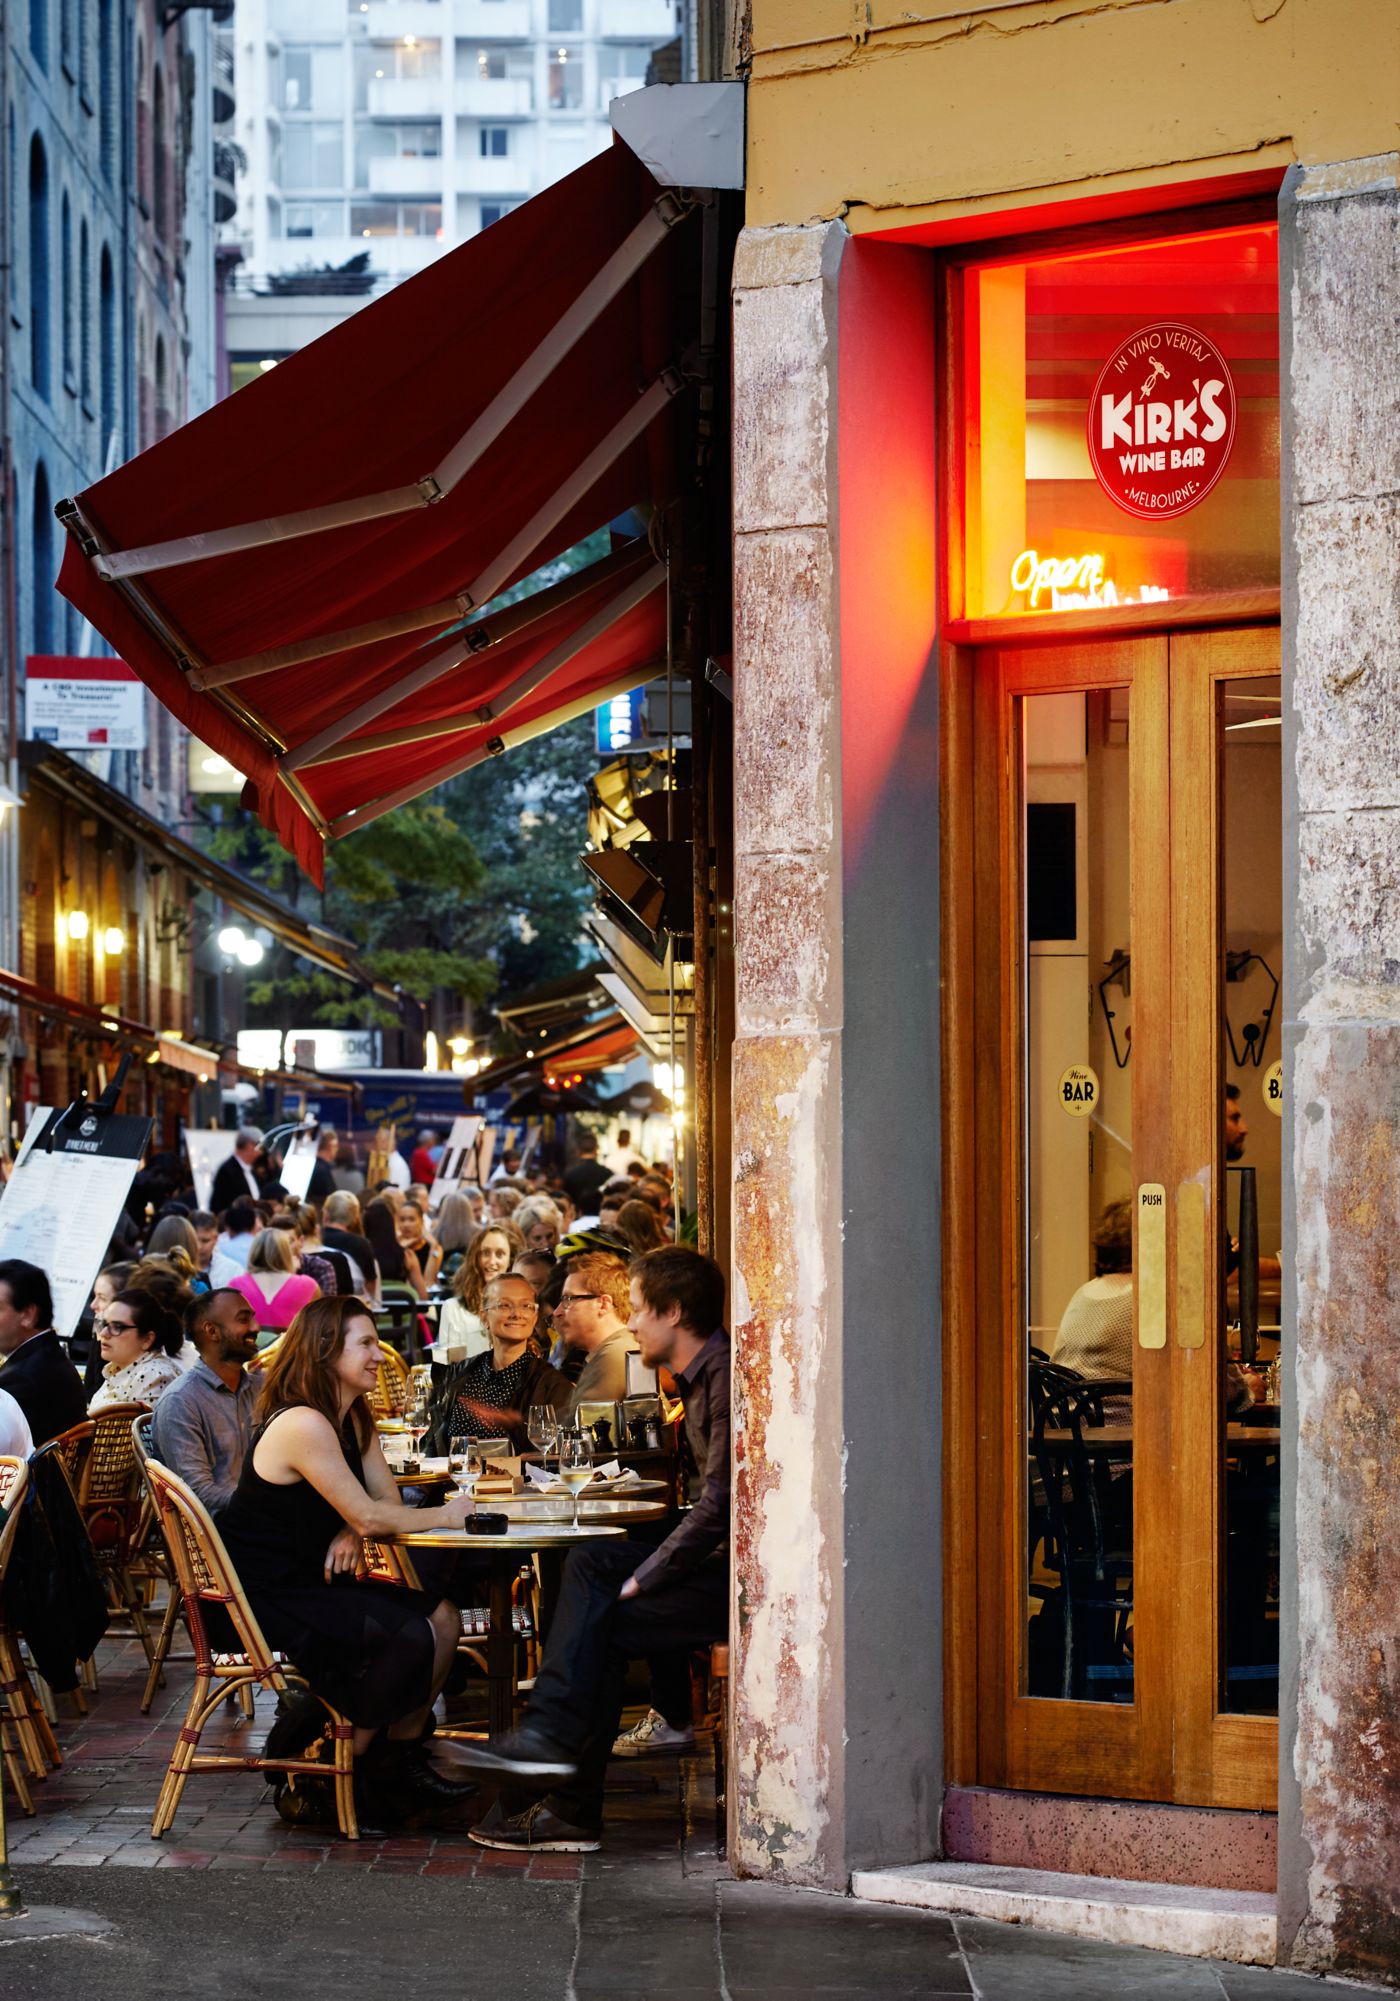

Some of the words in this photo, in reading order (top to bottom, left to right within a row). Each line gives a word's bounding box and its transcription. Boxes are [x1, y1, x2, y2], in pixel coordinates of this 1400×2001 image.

[1114, 356, 1129, 374] IN
[1127, 333, 1161, 359] VINO
[1165, 331, 1211, 363] VERITAS
[1101, 378, 1227, 450] KIRK'S
[1118, 451, 1166, 477] WINE
[1170, 446, 1205, 470] BAR
[1128, 480, 1196, 508] MELBOURNE
[1010, 549, 1103, 608] Open
[1068, 1069, 1088, 1081] Wine
[1062, 1081, 1094, 1102] BAR
[1142, 1194, 1162, 1206] PUSH
